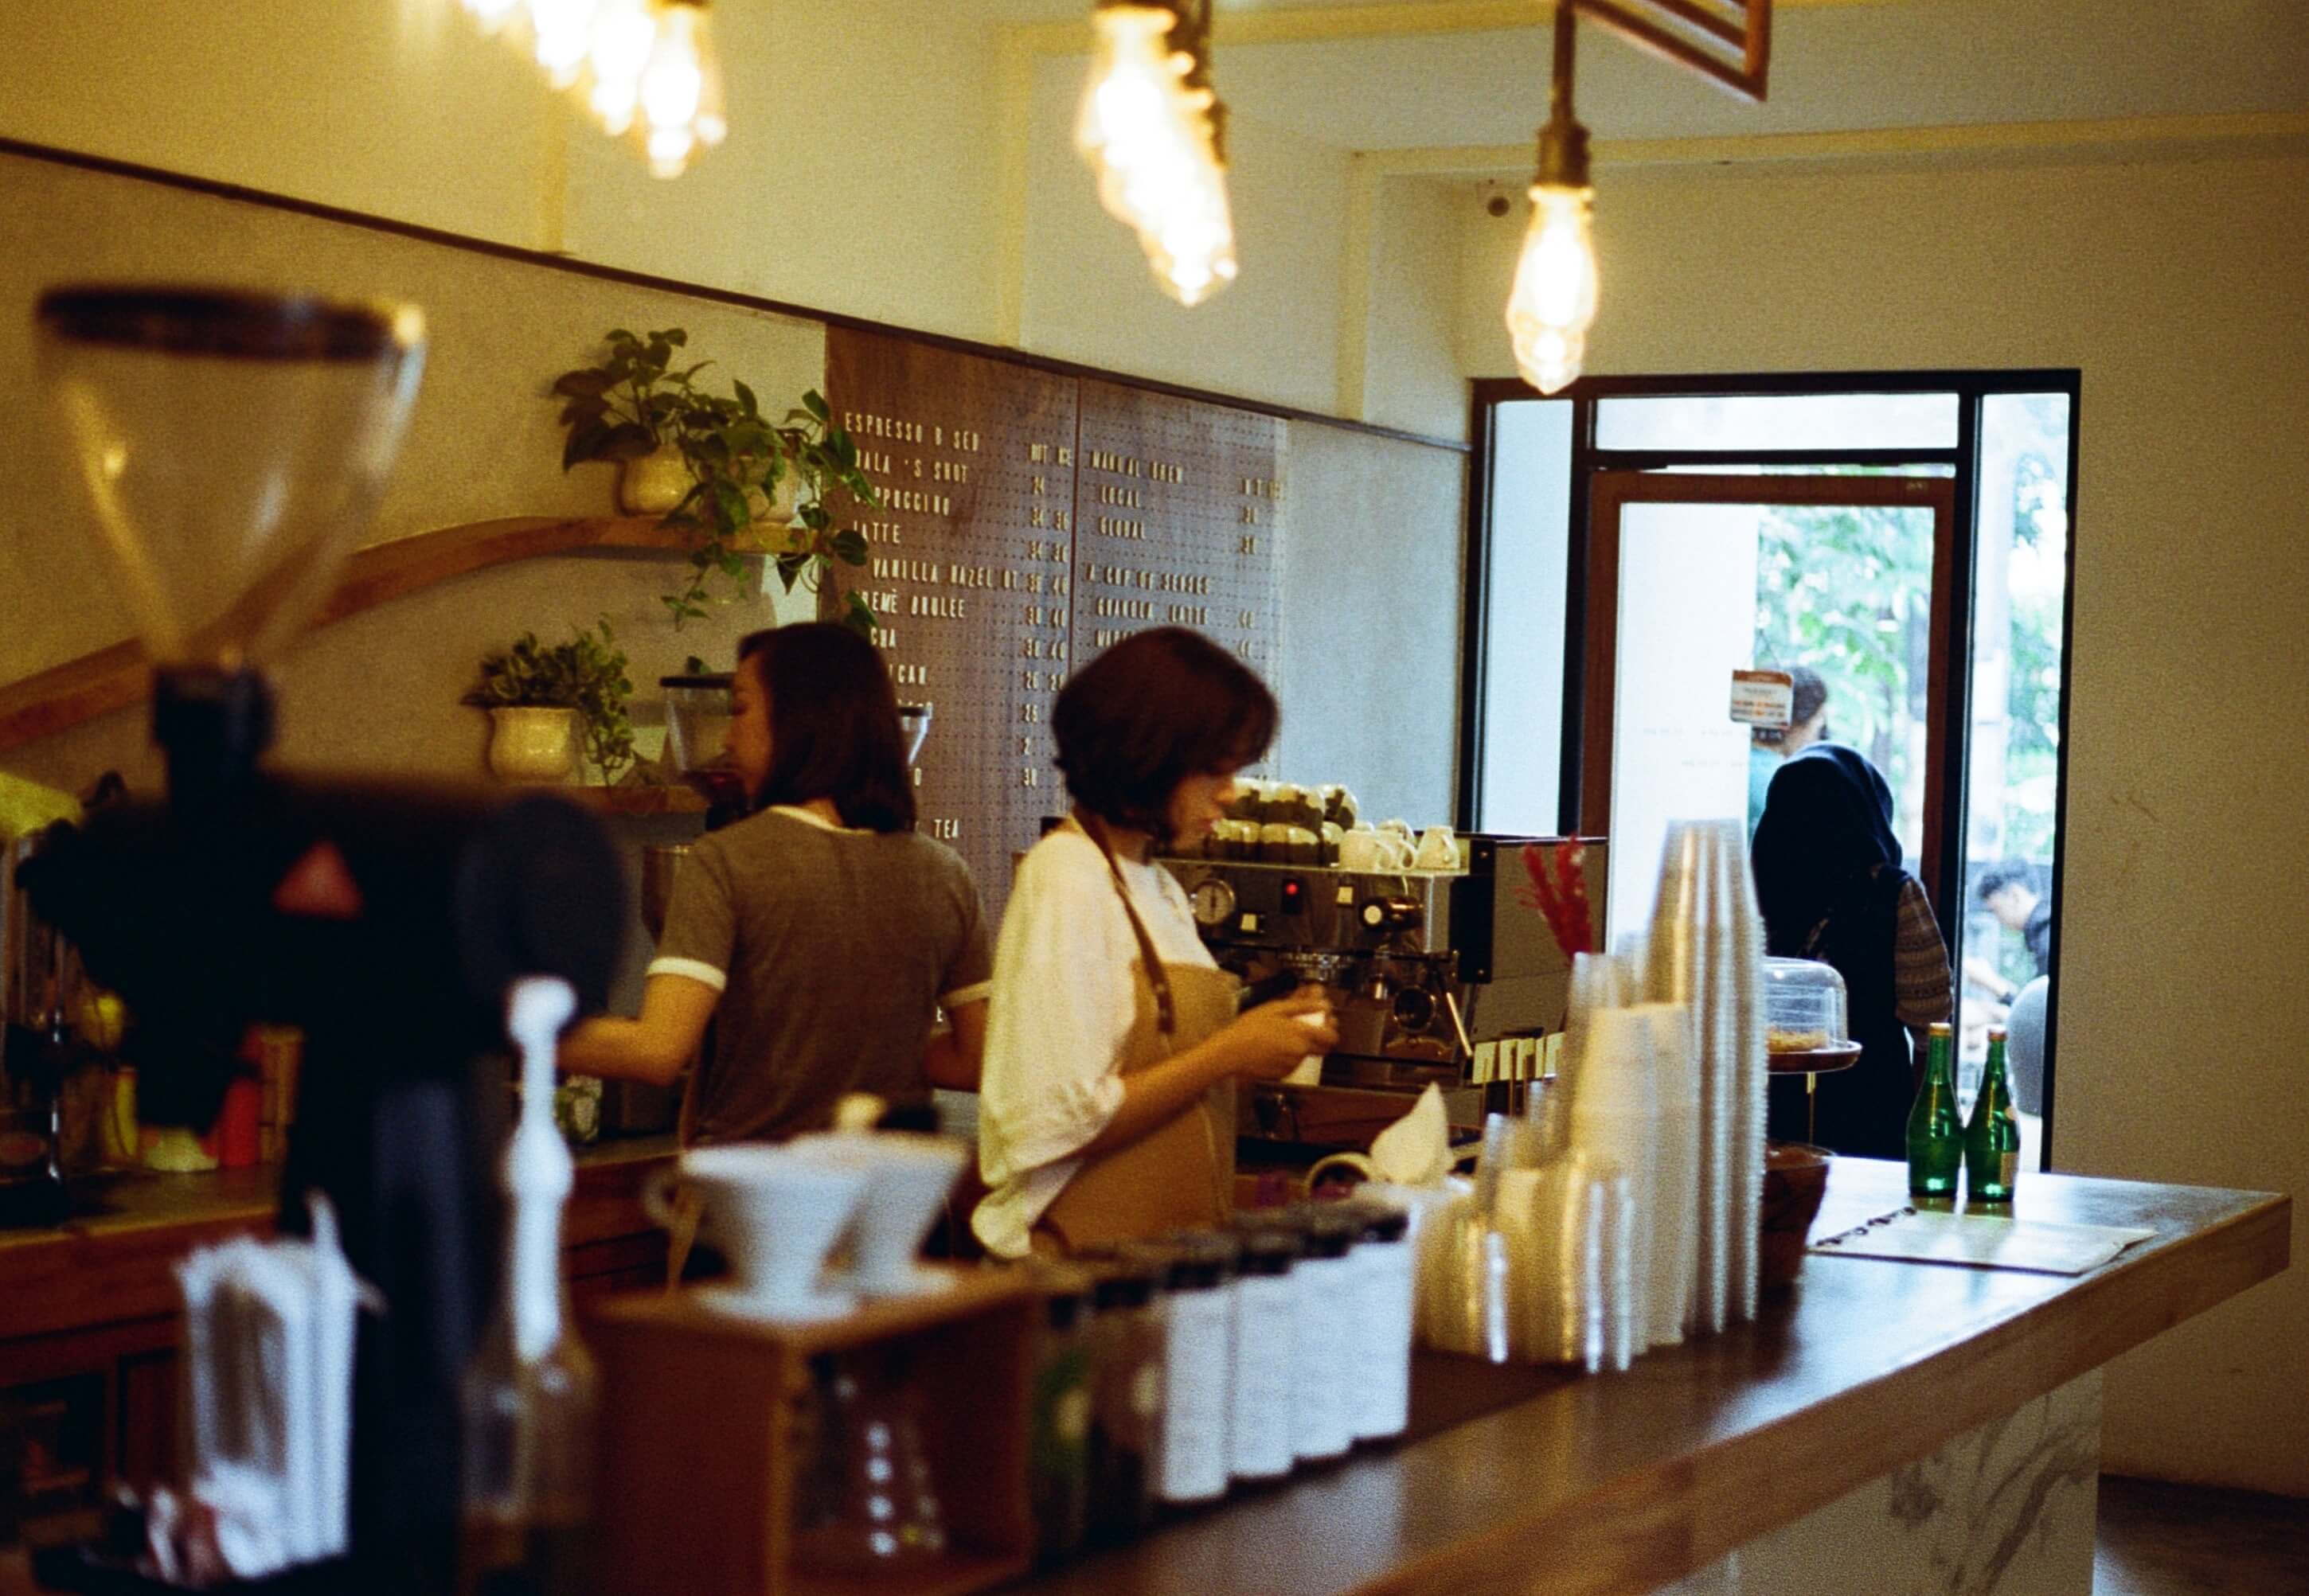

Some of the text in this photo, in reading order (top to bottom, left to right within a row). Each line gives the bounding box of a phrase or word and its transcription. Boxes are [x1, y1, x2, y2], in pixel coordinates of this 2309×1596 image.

[846, 412, 923, 443] ESPRESSO
[933, 462, 968, 484] SHOT
[1101, 485, 1140, 508] LOCAL
[1100, 516, 1147, 540] GLOBAL
[873, 559, 939, 583] VANILLA
[934, 819, 959, 839] TEA
